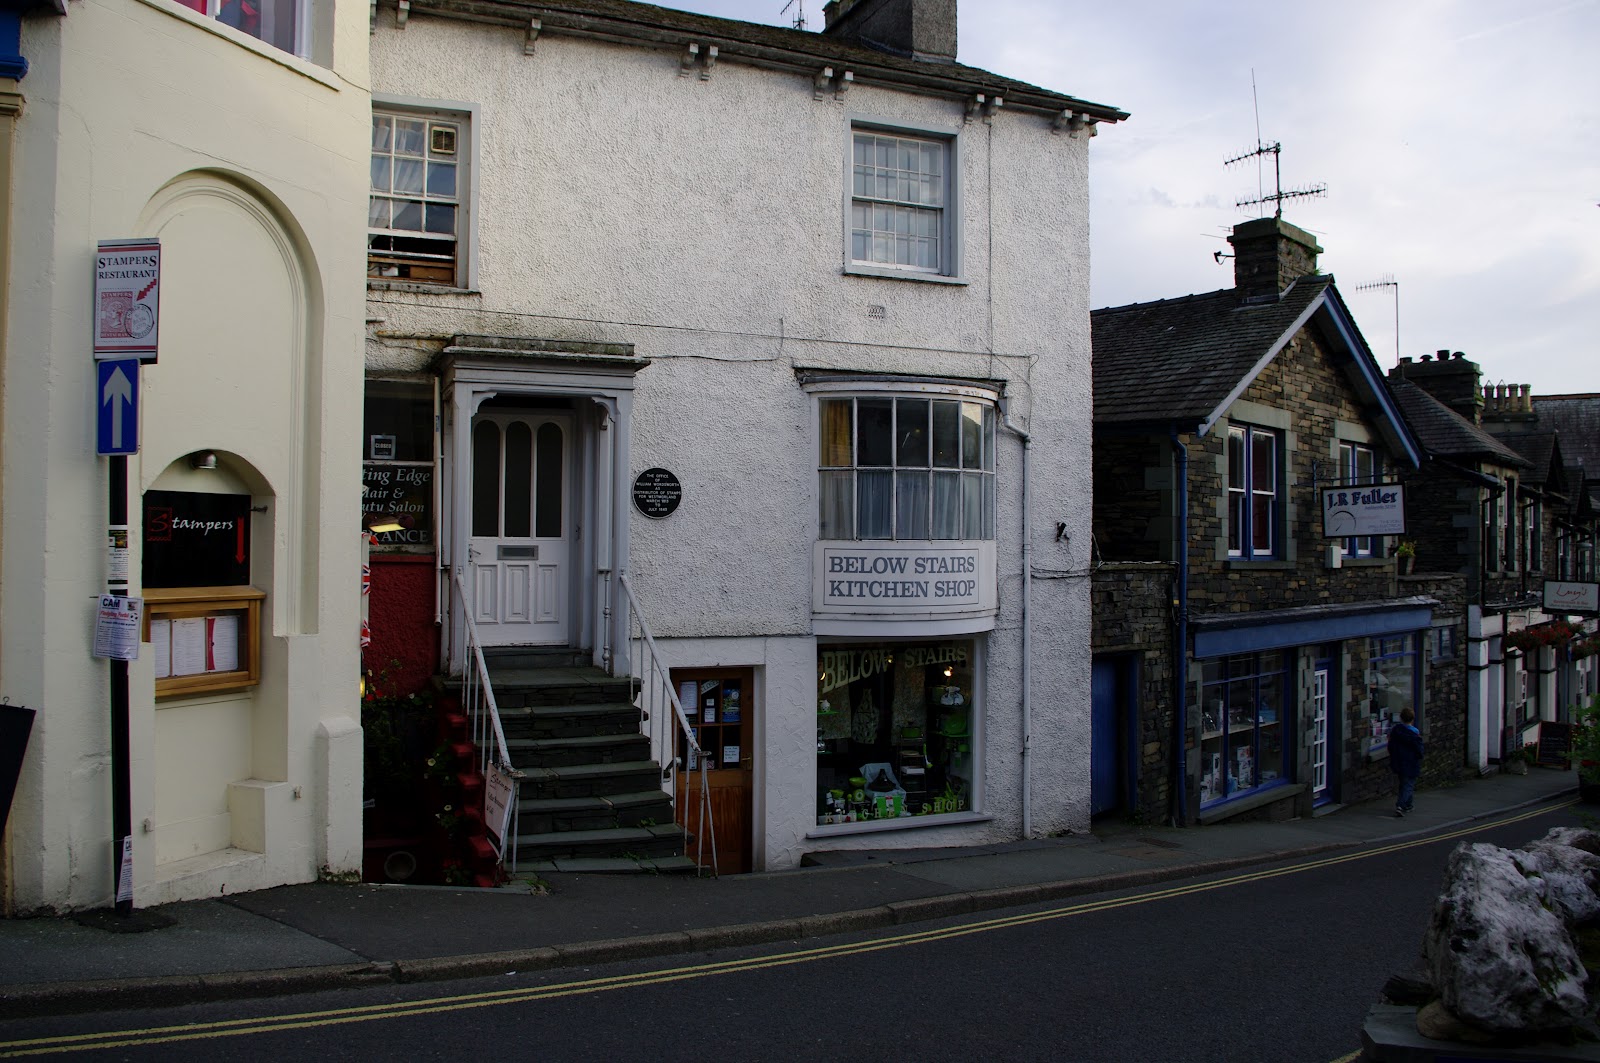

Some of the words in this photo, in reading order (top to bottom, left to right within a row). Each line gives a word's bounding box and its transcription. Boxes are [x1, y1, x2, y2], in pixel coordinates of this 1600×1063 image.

[98, 256, 157, 269] STAMPERS
[98, 271, 157, 280] RESTAURANT
[363, 468, 391, 486] ting
[396, 468, 431, 487] Edge
[393, 487, 405, 499] &
[1351, 489, 1398, 506] Fuller
[389, 501, 425, 512] Salon
[149, 512, 234, 537] Stampers
[829, 556, 909, 574] BELOW
[914, 555, 975, 574] STAIRS
[829, 580, 930, 598] KITCHEN
[934, 579, 977, 598] SHOP
[103, 598, 120, 607] CAM
[822, 650, 894, 694] BELOW
[905, 647, 968, 669] STAIRS
[922, 800, 965, 814] SHOP
